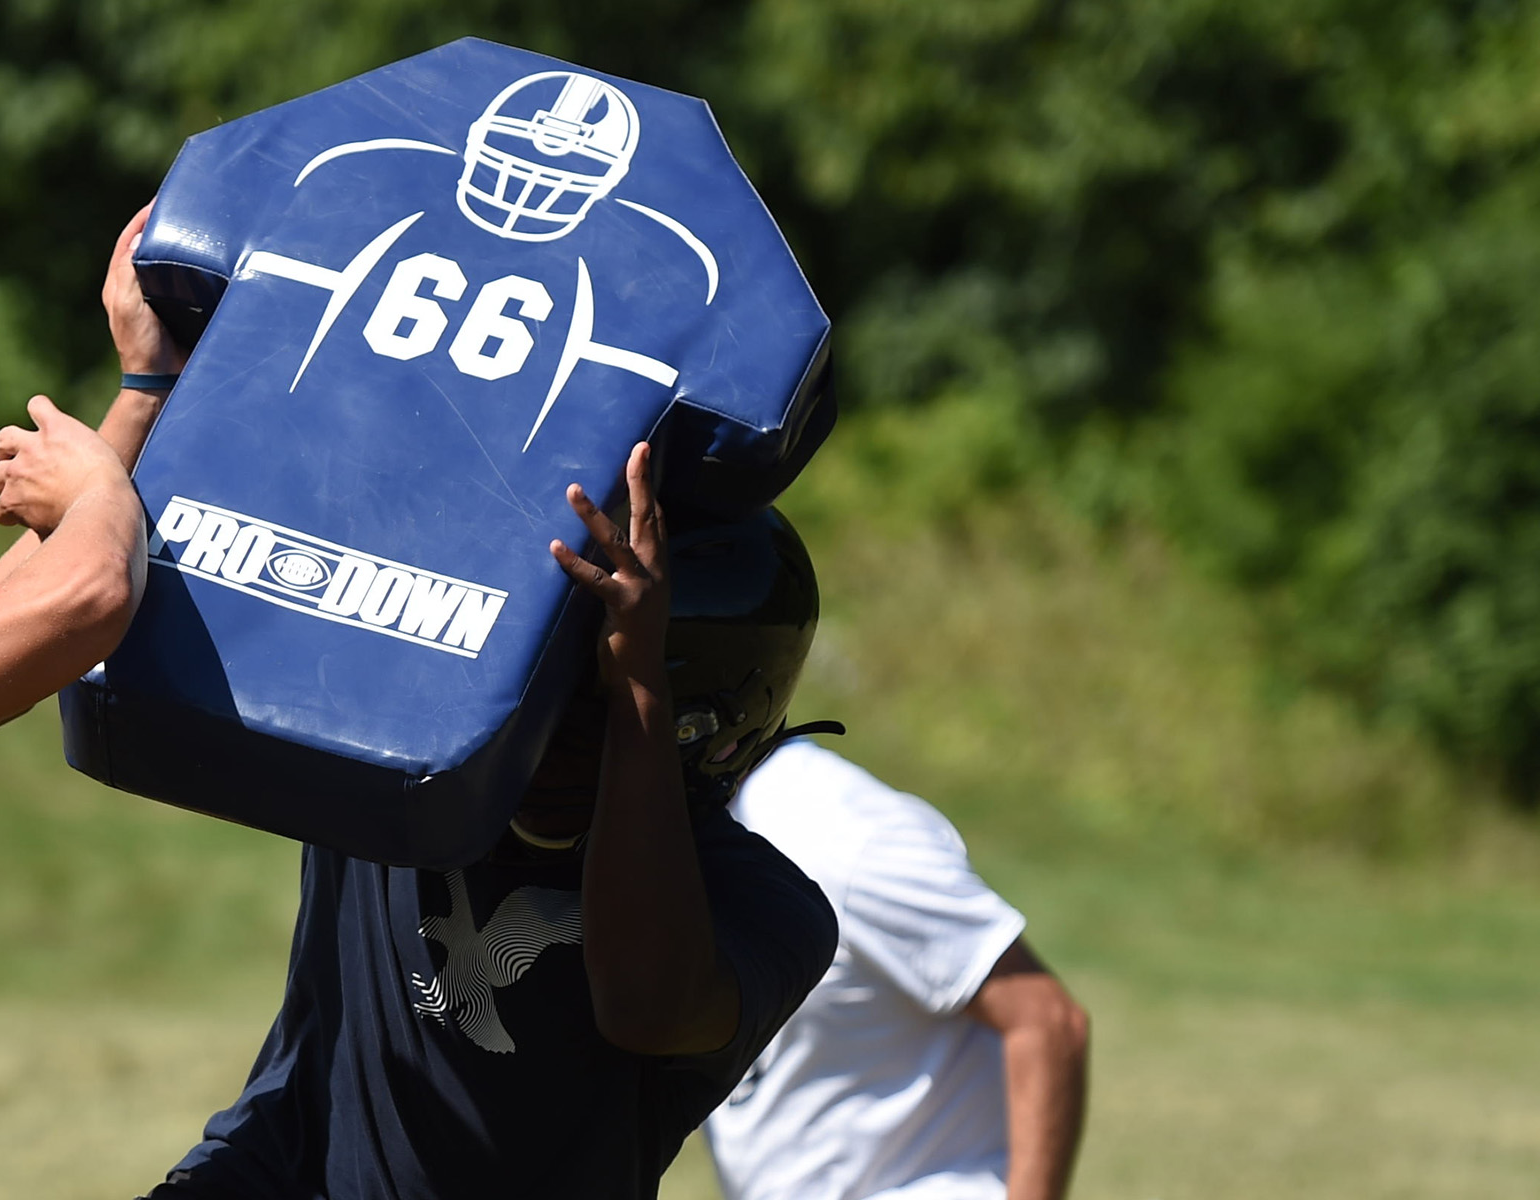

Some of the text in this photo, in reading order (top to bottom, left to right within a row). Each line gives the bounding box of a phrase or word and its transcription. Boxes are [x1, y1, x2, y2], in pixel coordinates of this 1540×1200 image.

[362, 252, 555, 381] 66
[149, 500, 506, 652] PRO DOWN
